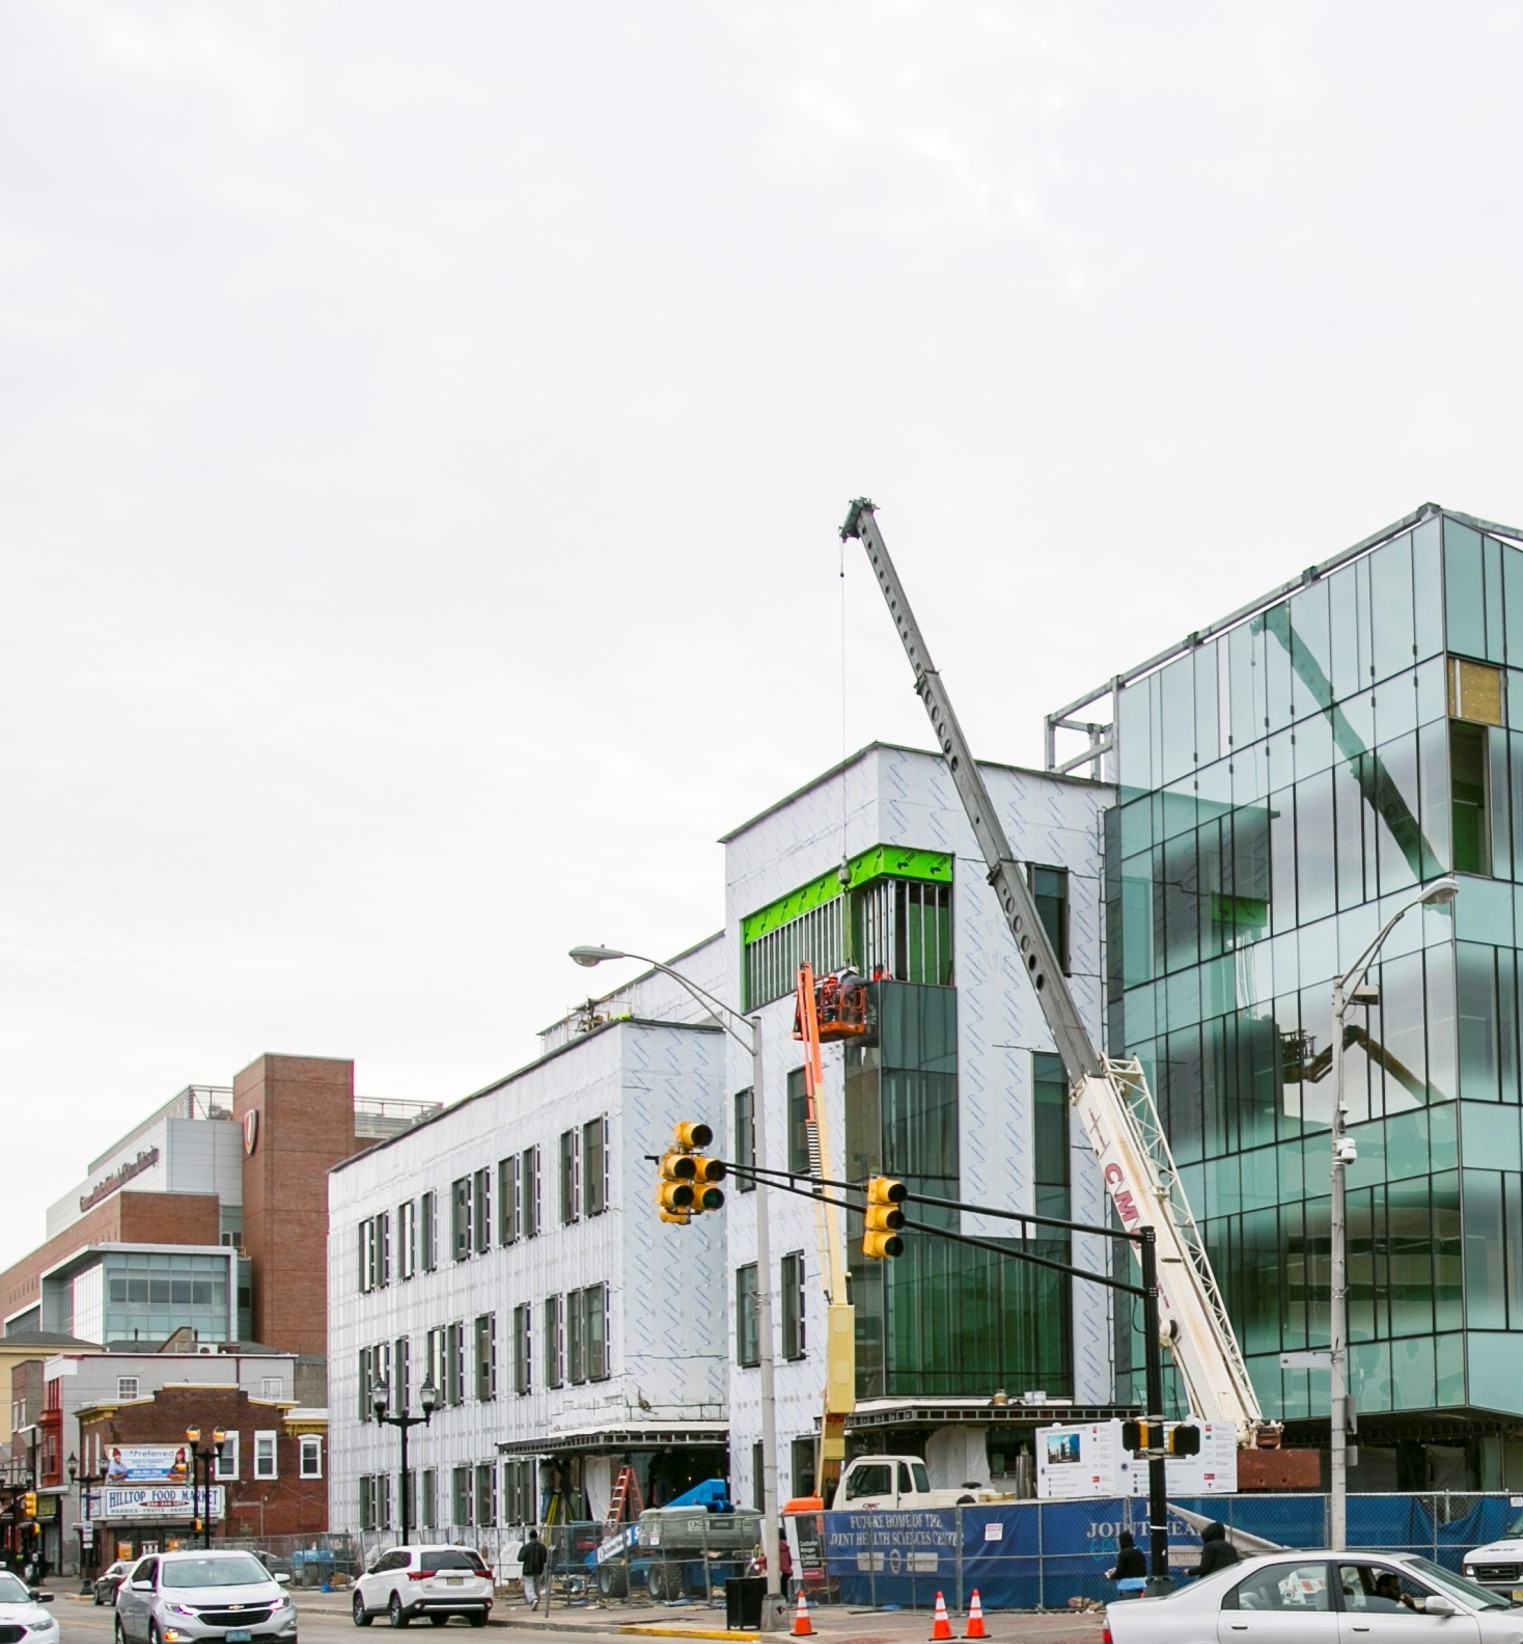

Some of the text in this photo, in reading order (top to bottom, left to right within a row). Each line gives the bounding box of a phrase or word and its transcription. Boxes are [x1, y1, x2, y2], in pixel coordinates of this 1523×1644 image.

[109, 1490, 146, 1508] HILLTOP
[152, 1490, 176, 1501] FOOD
[885, 1514, 912, 1529] HOME
[912, 1514, 924, 1528] OF
[829, 1532, 854, 1546] JOINT
[856, 1531, 890, 1546] HELTH
